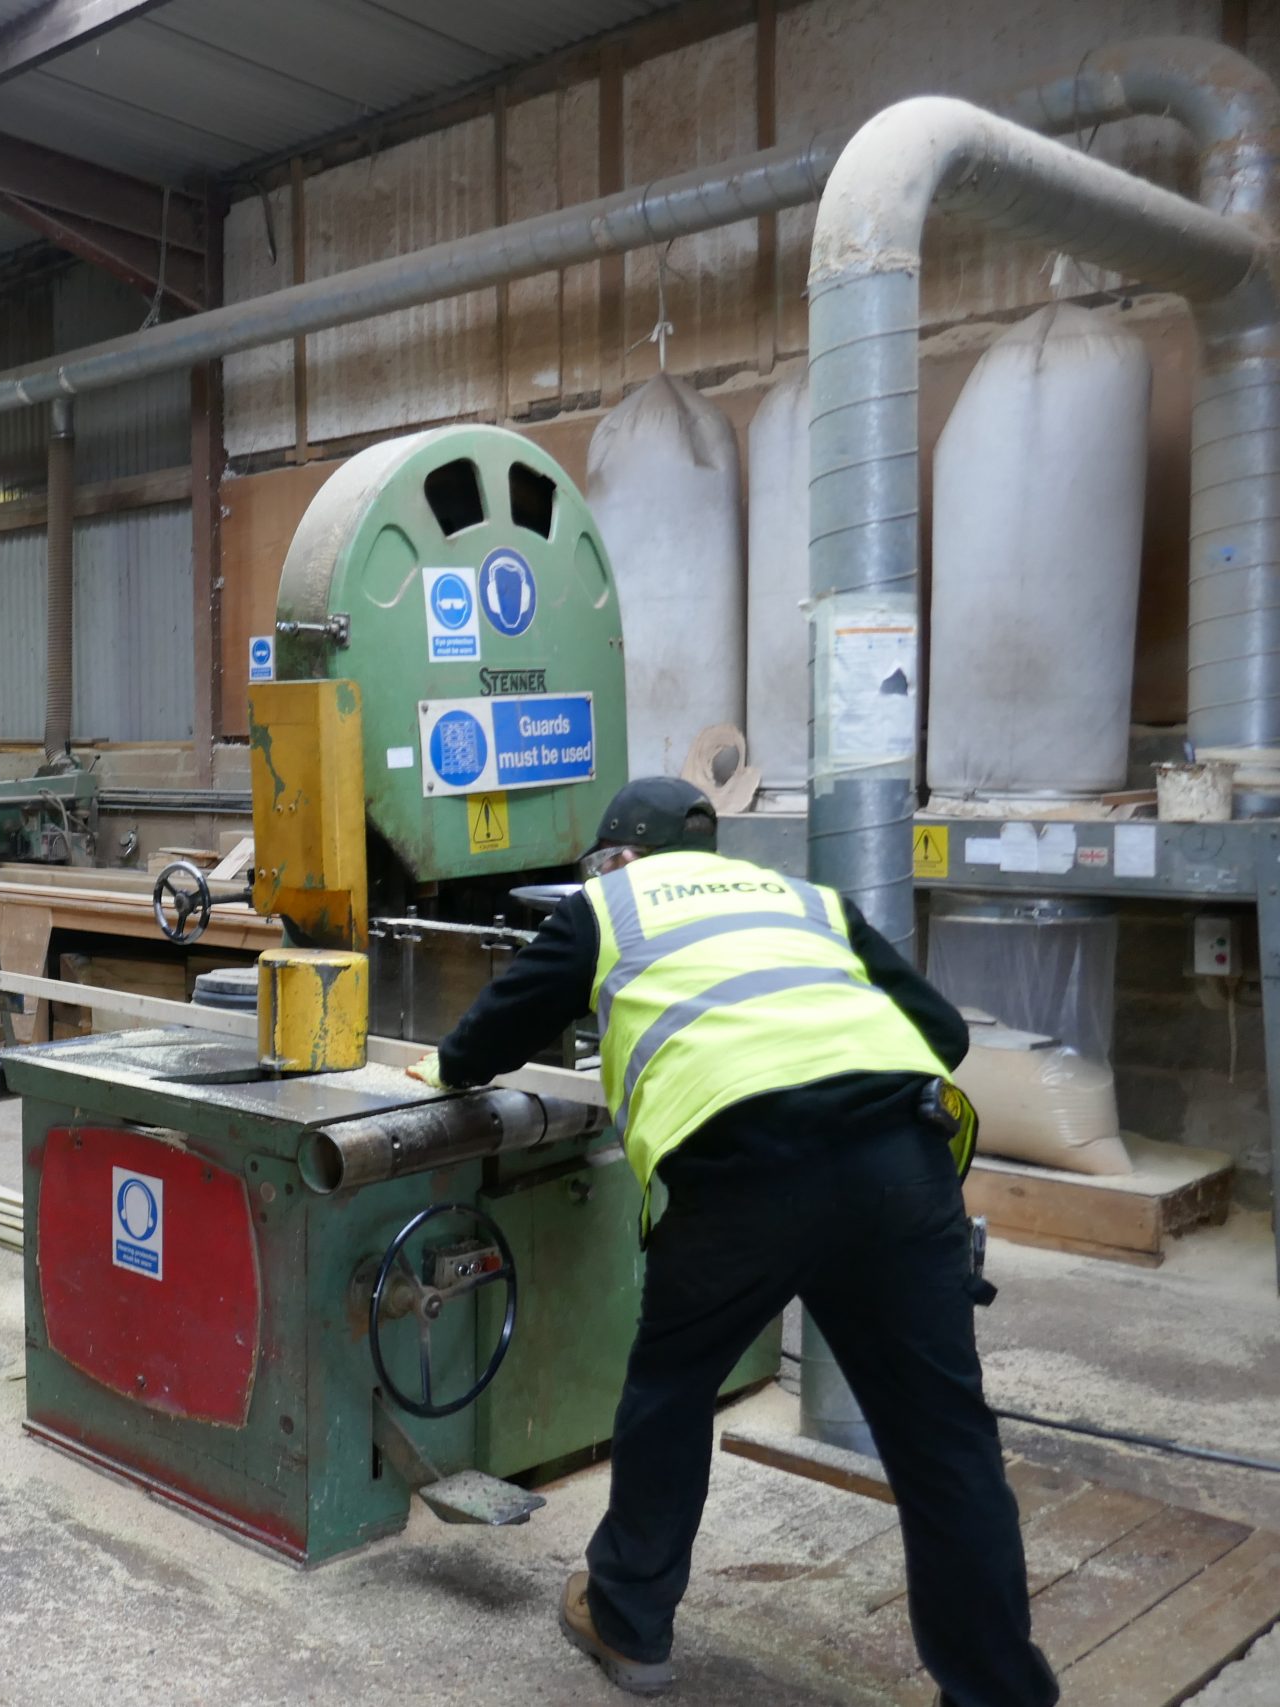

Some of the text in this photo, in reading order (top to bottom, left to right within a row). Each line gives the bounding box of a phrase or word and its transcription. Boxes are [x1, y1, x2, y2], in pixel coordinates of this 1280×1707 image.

[479, 667, 547, 696] STENNER
[519, 713, 570, 737] Guards
[498, 740, 591, 769] must be used
